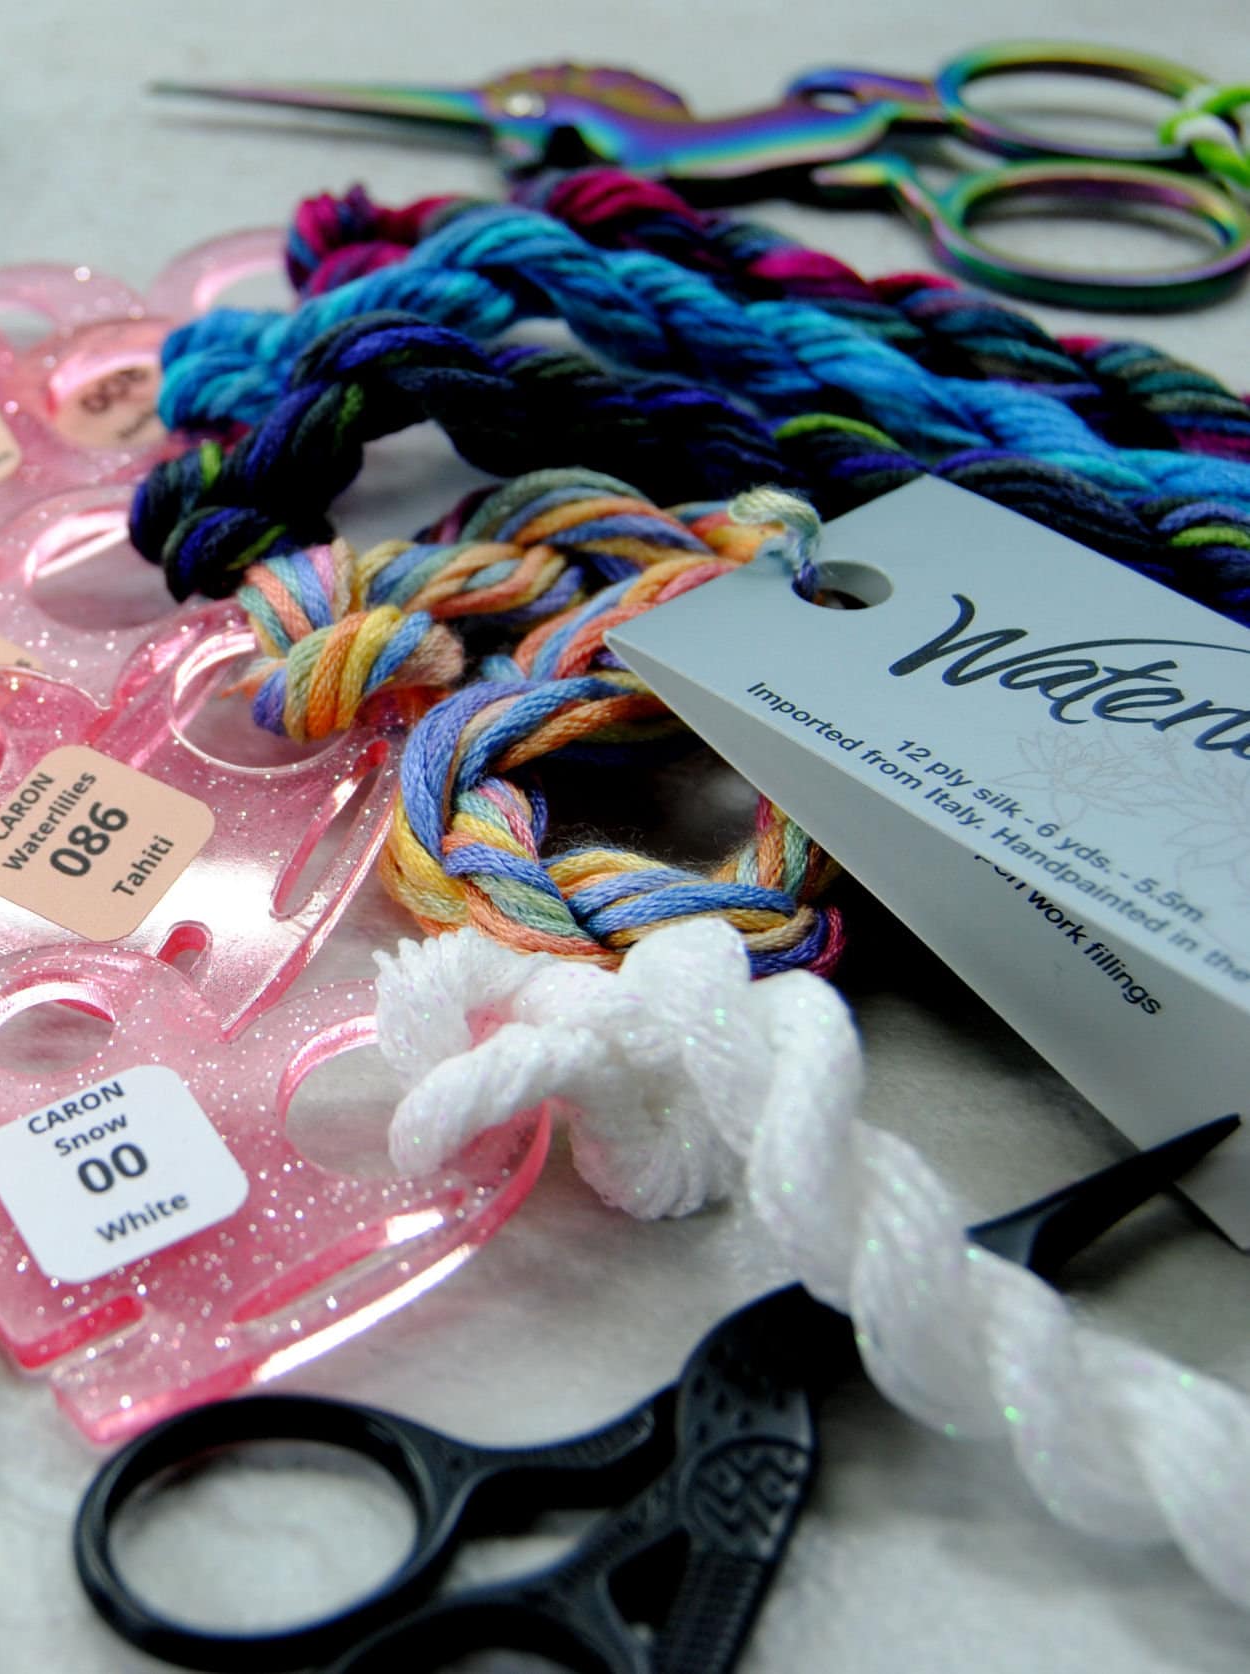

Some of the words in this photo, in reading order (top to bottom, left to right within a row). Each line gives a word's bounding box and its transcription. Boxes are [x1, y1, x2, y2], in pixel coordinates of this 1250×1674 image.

[2, 771, 97, 872] Waterlilies
[49, 801, 129, 878] 086
[747, 682, 864, 752] Imported
[859, 749, 923, 791] from
[924, 787, 986, 830] Italy.
[990, 826, 1170, 933] Handpainted
[1168, 932, 1199, 954] in
[1203, 949, 1250, 983] the
[896, 739, 931, 763] 12
[924, 762, 973, 789] ply
[973, 787, 1023, 820] silk
[1036, 822, 1061, 839] 6
[1054, 837, 1112, 874] yds.
[1134, 878, 1205, 924] 5.5m
[111, 834, 175, 897] Tahiti
[1027, 889, 1087, 946] work
[1083, 942, 1163, 1015] fillings
[27, 1080, 126, 1137] CARON
[54, 1111, 129, 1157] Snow
[76, 1140, 149, 1195] 00
[95, 1190, 190, 1245] White
